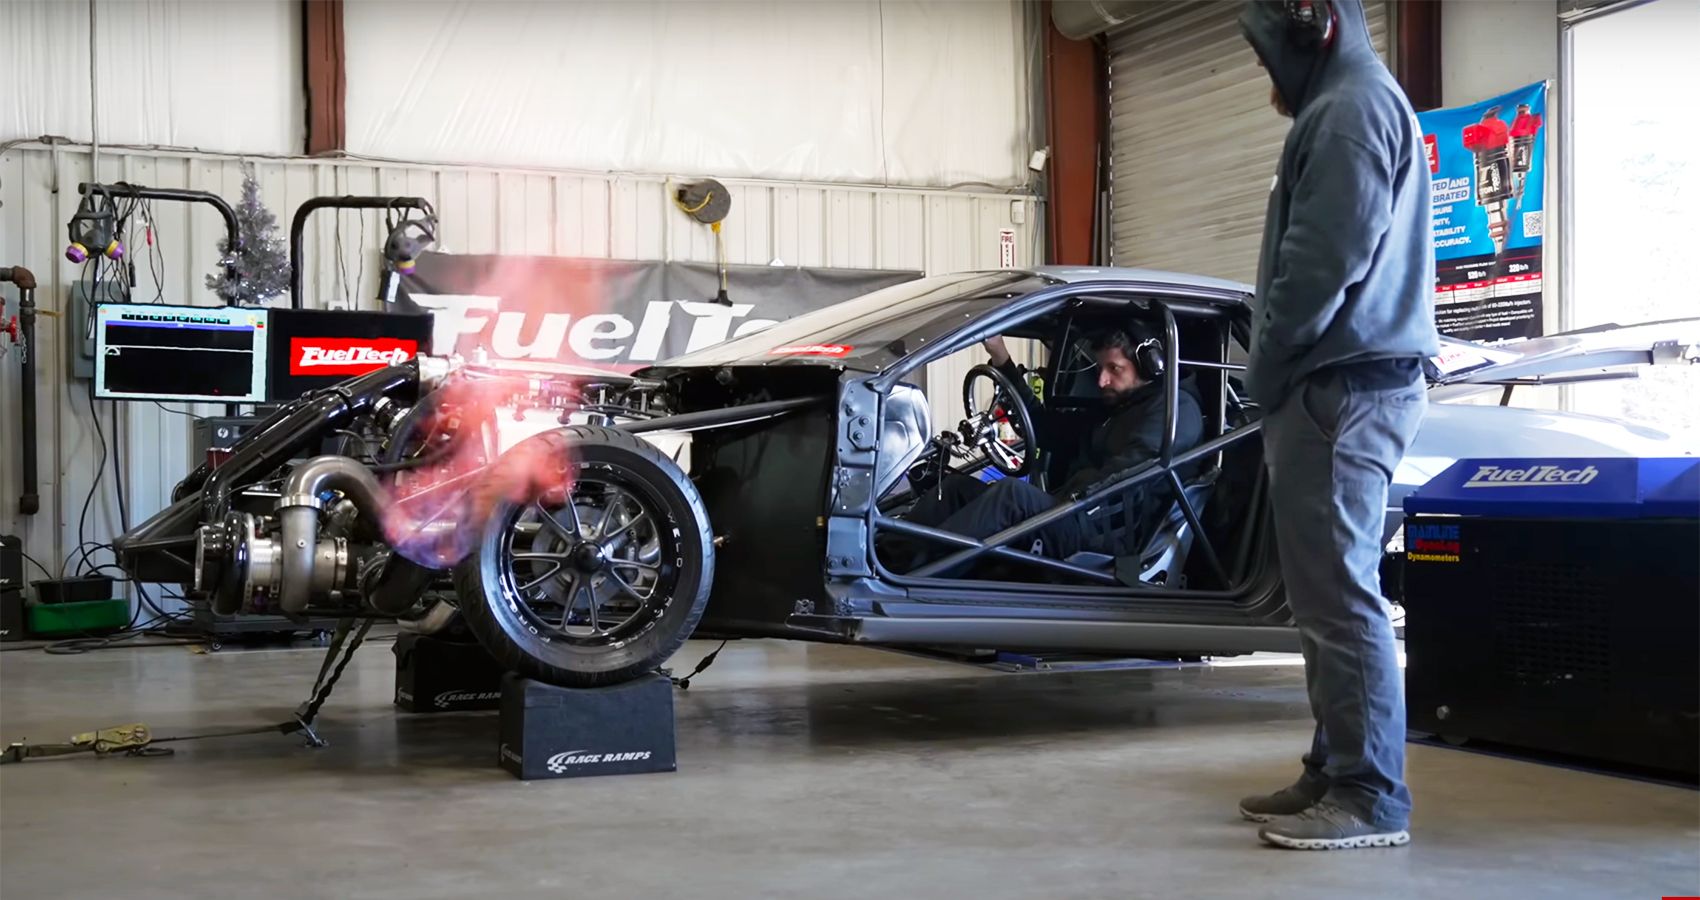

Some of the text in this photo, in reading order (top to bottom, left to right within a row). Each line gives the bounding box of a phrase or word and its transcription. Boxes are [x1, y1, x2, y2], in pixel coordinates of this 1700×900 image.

[1450, 177, 1469, 187] AND
[300, 346, 408, 366] FuelTech
[1462, 465, 1599, 487] FuelTech
[1408, 552, 1460, 562] Dynamometers
[447, 693, 478, 701] RACE
[564, 751, 652, 765] RACE RAMPS
